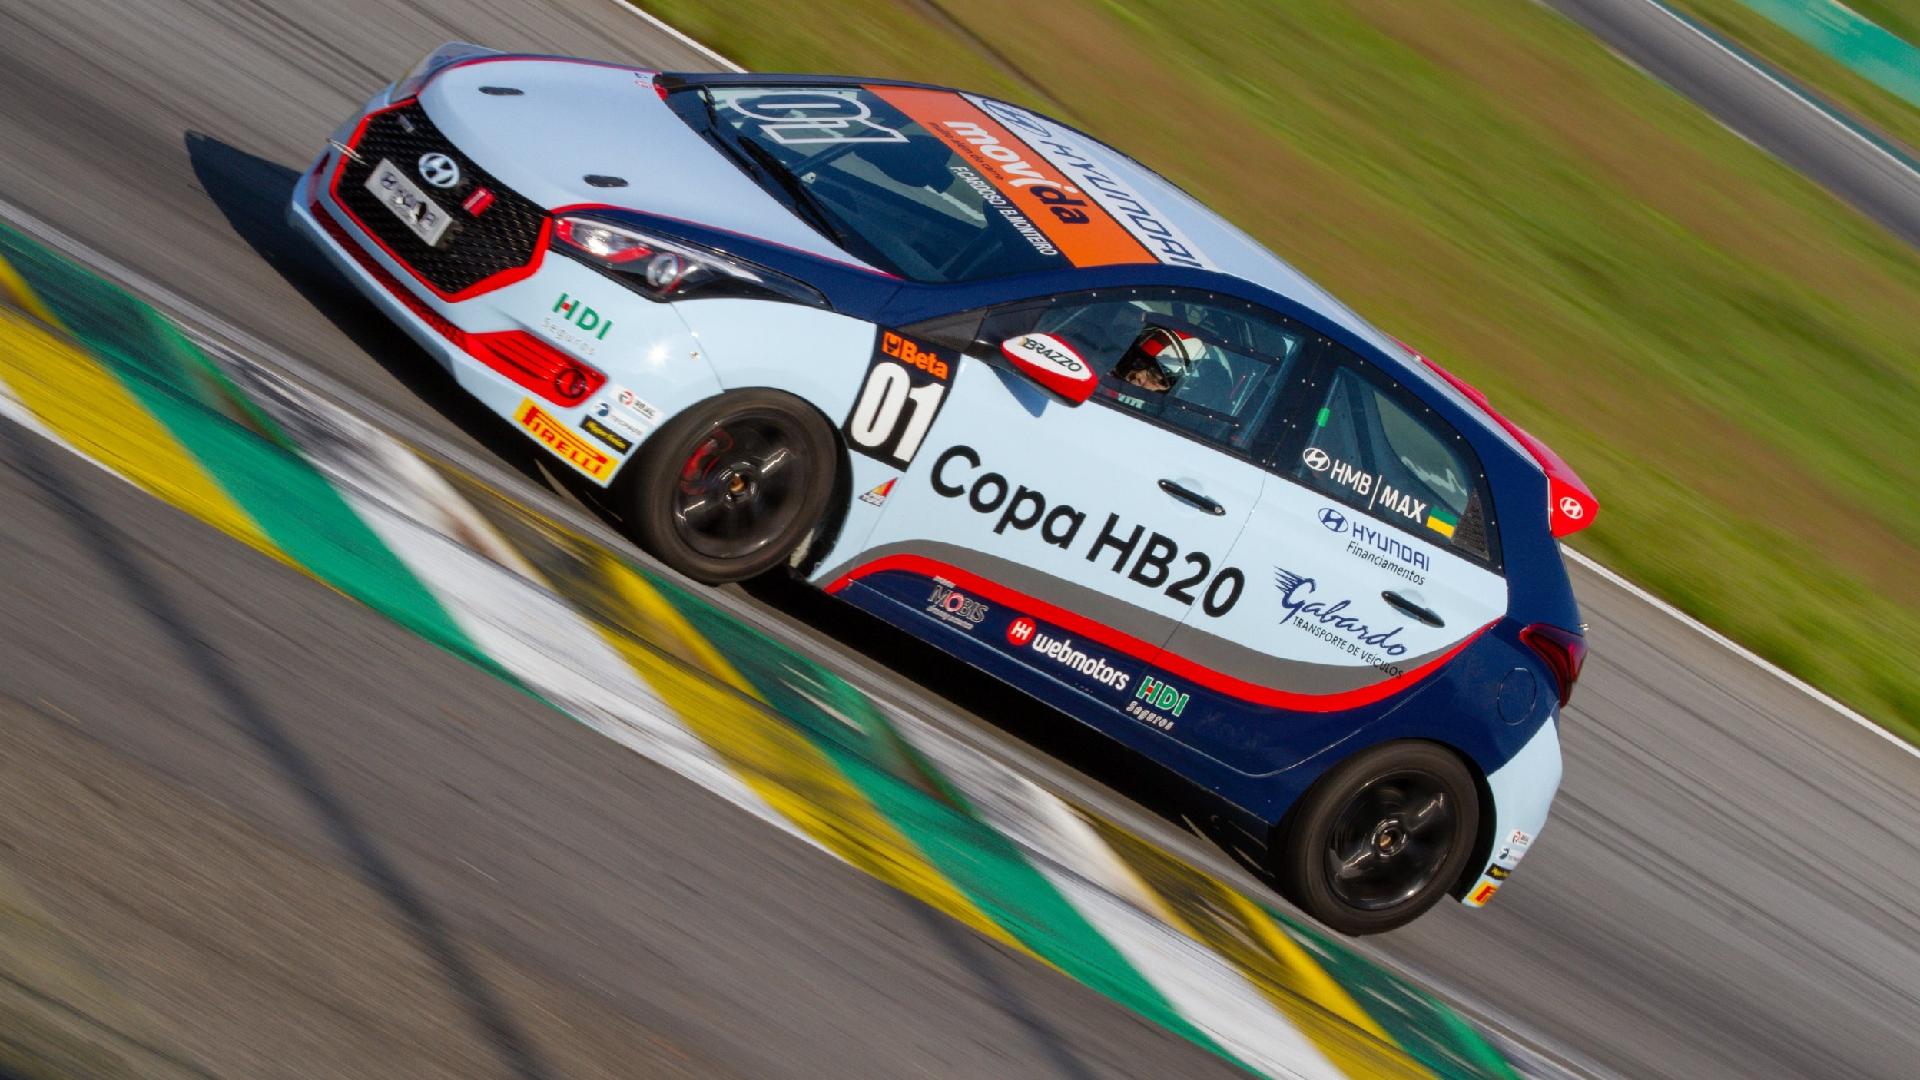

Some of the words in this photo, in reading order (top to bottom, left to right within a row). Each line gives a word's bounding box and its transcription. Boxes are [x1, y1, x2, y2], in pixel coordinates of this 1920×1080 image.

[943, 121, 1090, 225] movida
[1039, 140, 1203, 268] HYUNDAI
[552, 292, 613, 341] HDI
[900, 340, 948, 380] Beta
[1022, 335, 1082, 373] BRAZZO
[522, 405, 608, 475] PIRELLI
[850, 362, 945, 463] 01
[1330, 459, 1373, 496] HMB
[1379, 485, 1427, 524] MAX
[930, 445, 1086, 550] Copa
[1085, 512, 1245, 618] HB20
[1352, 521, 1431, 573] HYUNDAI
[1346, 540, 1426, 587] Financiamentos
[926, 584, 989, 623] MOBIS
[1273, 564, 1408, 657] Gabardo
[1032, 632, 1130, 692] webmotors
[1292, 615, 1347, 651] TRANSPORTE
[1347, 643, 1360, 658] DE
[1360, 647, 1405, 680] VEÍCULOS
[1125, 700, 1176, 732] Seguros
[1135, 676, 1191, 718] HDI
